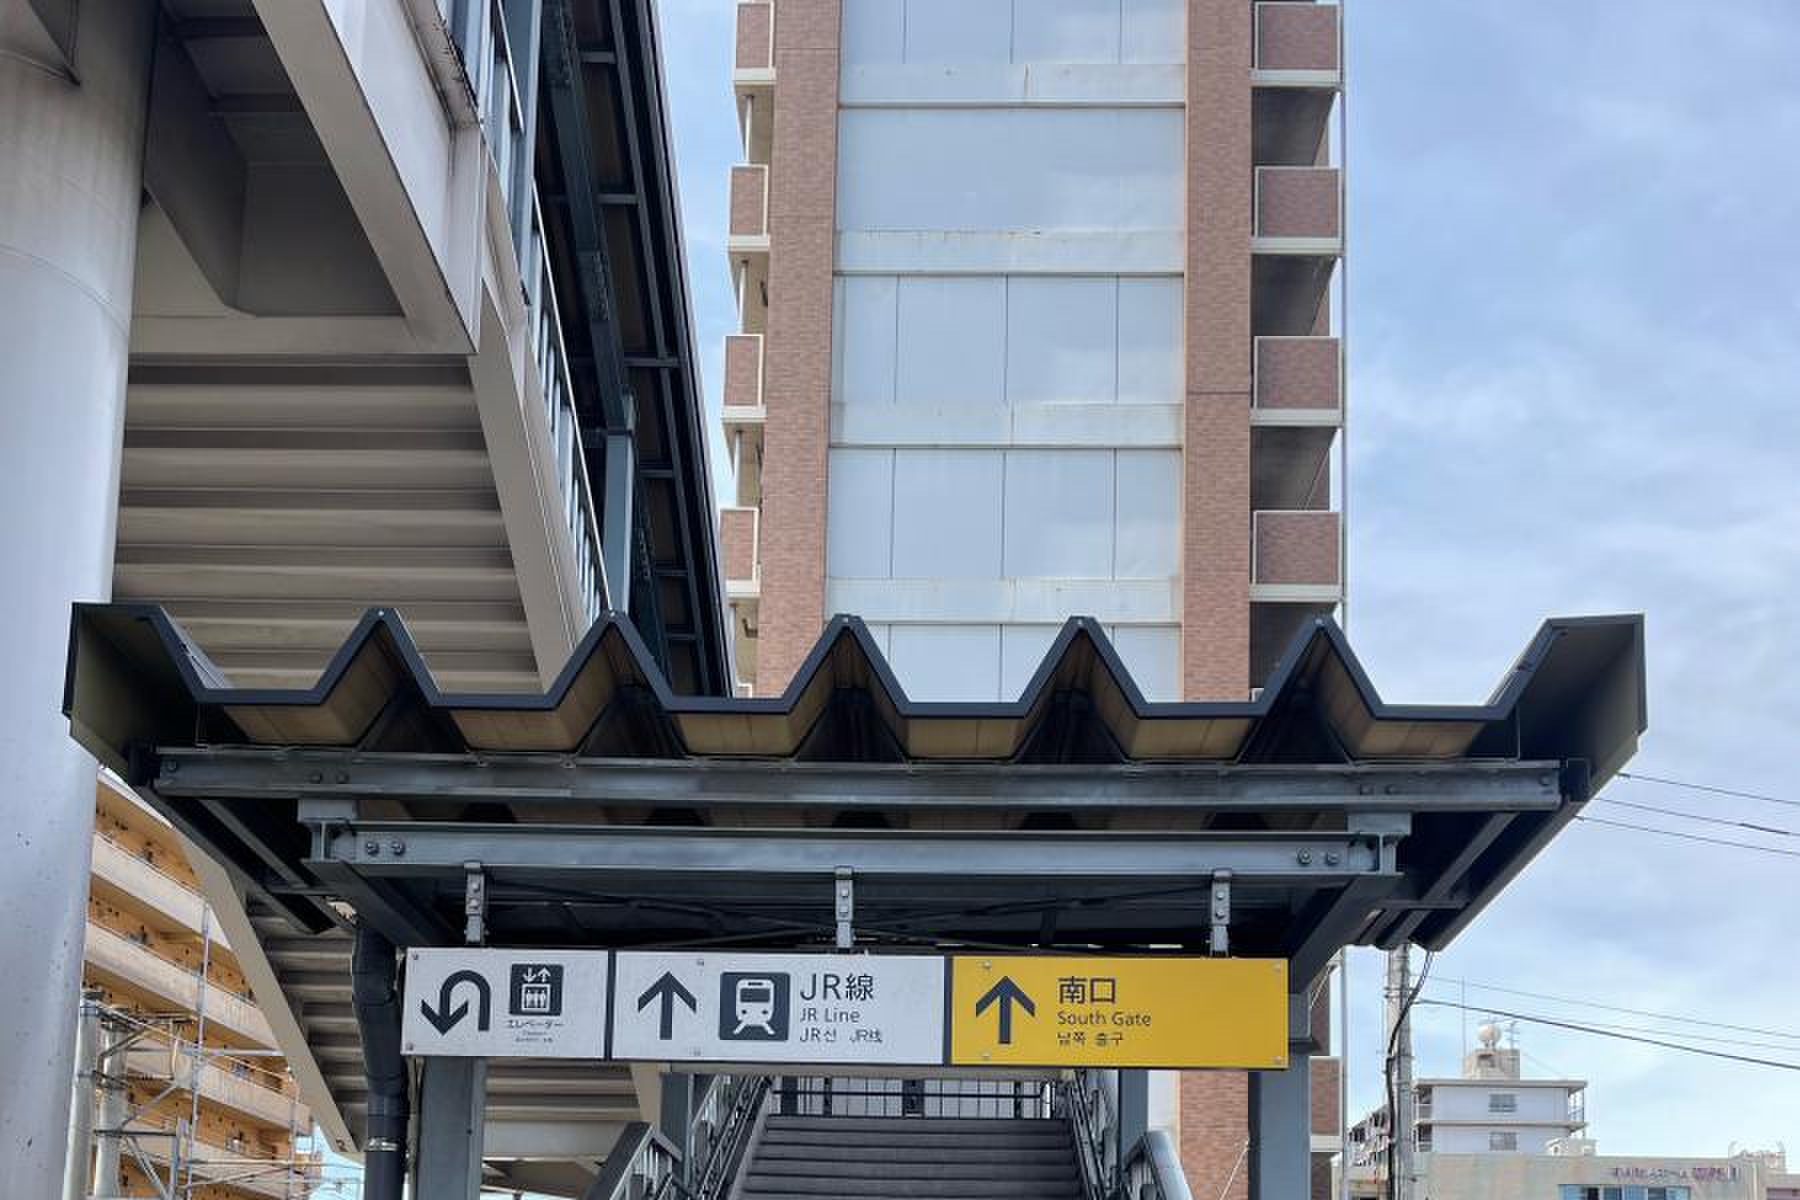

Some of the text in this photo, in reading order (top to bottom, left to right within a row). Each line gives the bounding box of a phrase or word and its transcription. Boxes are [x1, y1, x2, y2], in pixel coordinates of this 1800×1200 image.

[800, 973, 873, 1000] JR線
[1058, 976, 1116, 1003] 南口
[800, 1008, 860, 1022] JR Line
[1058, 1010, 1151, 1026] South Gate
